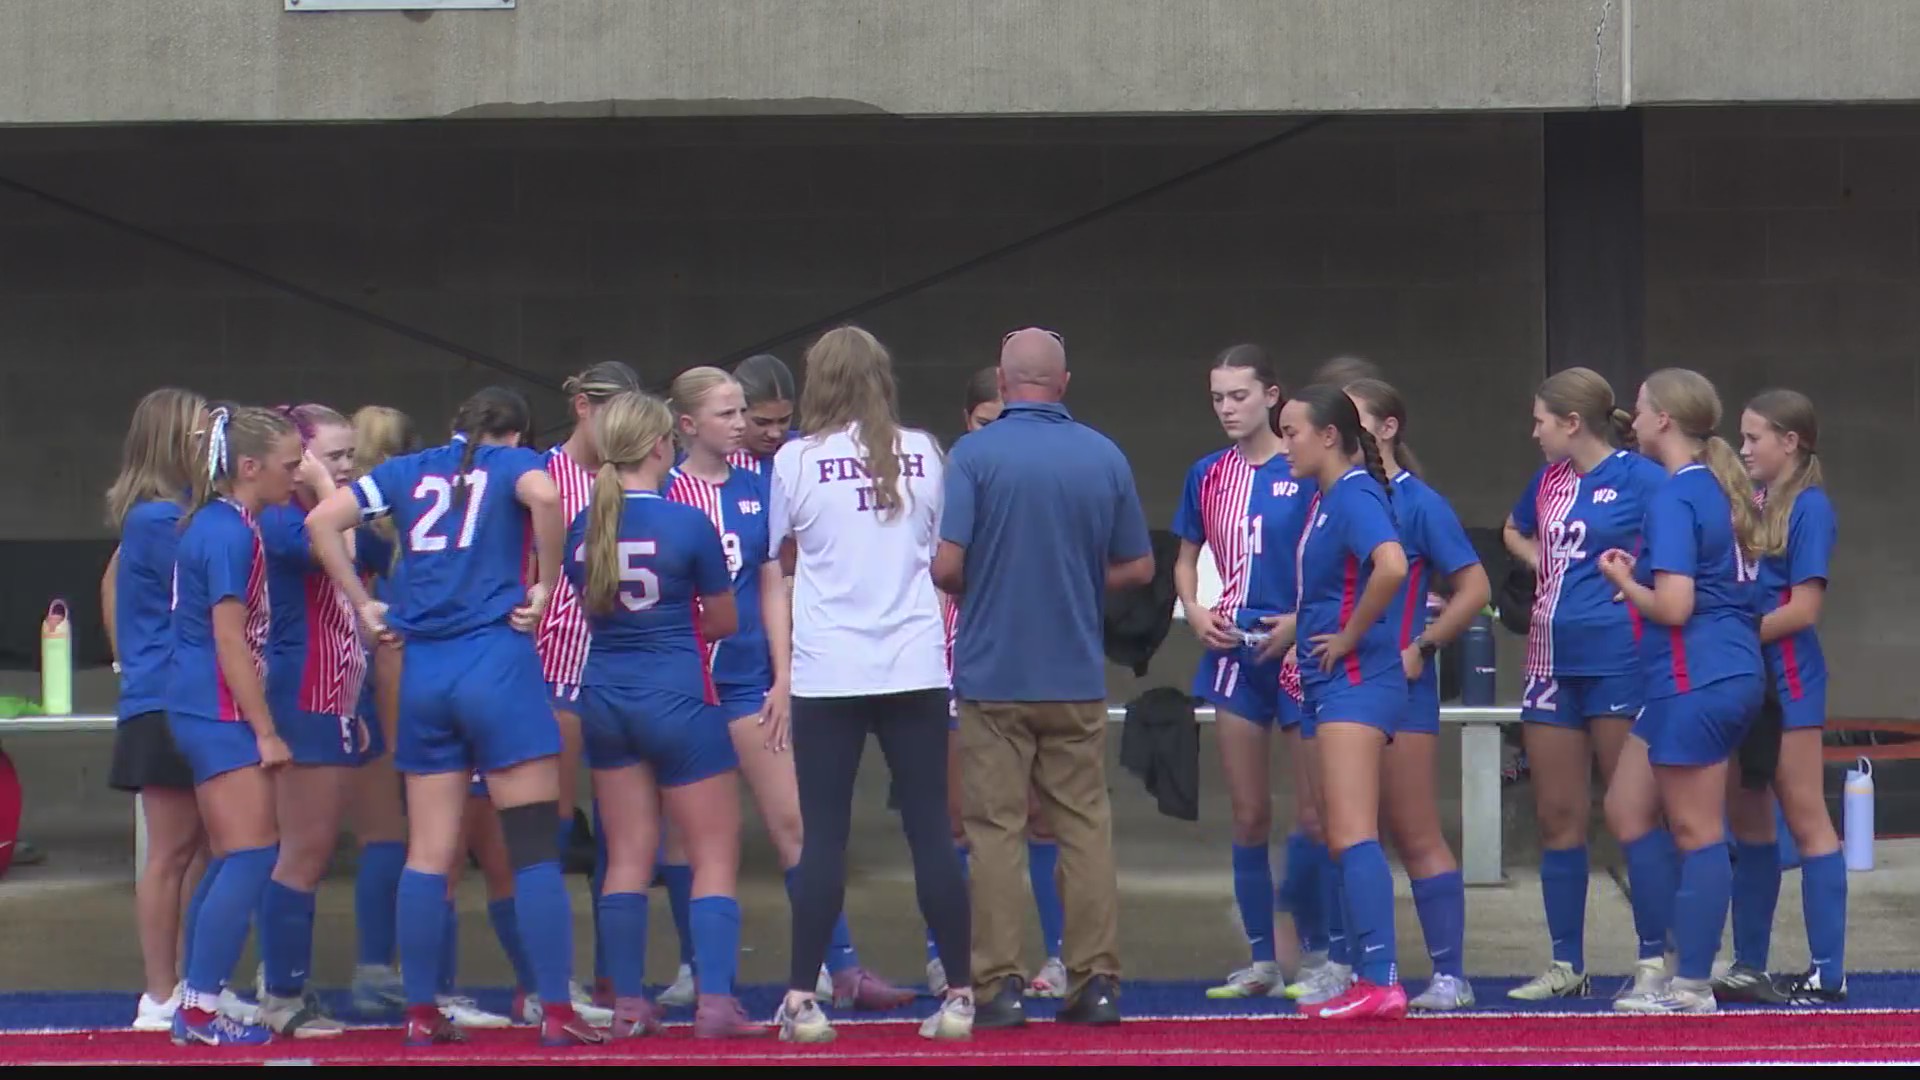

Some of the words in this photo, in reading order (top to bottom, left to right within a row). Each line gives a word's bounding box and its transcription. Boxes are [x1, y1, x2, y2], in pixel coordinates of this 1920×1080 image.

[816, 453, 925, 484] FINH
[737, 499, 762, 515] WP
[1272, 481, 1299, 497] WP
[1592, 488, 1618, 504] WP
[408, 468, 488, 552] 27
[1239, 515, 1262, 554] 11
[1548, 520, 1587, 559] 22
[574, 541, 660, 612] 5
[1214, 656, 1240, 698] 11
